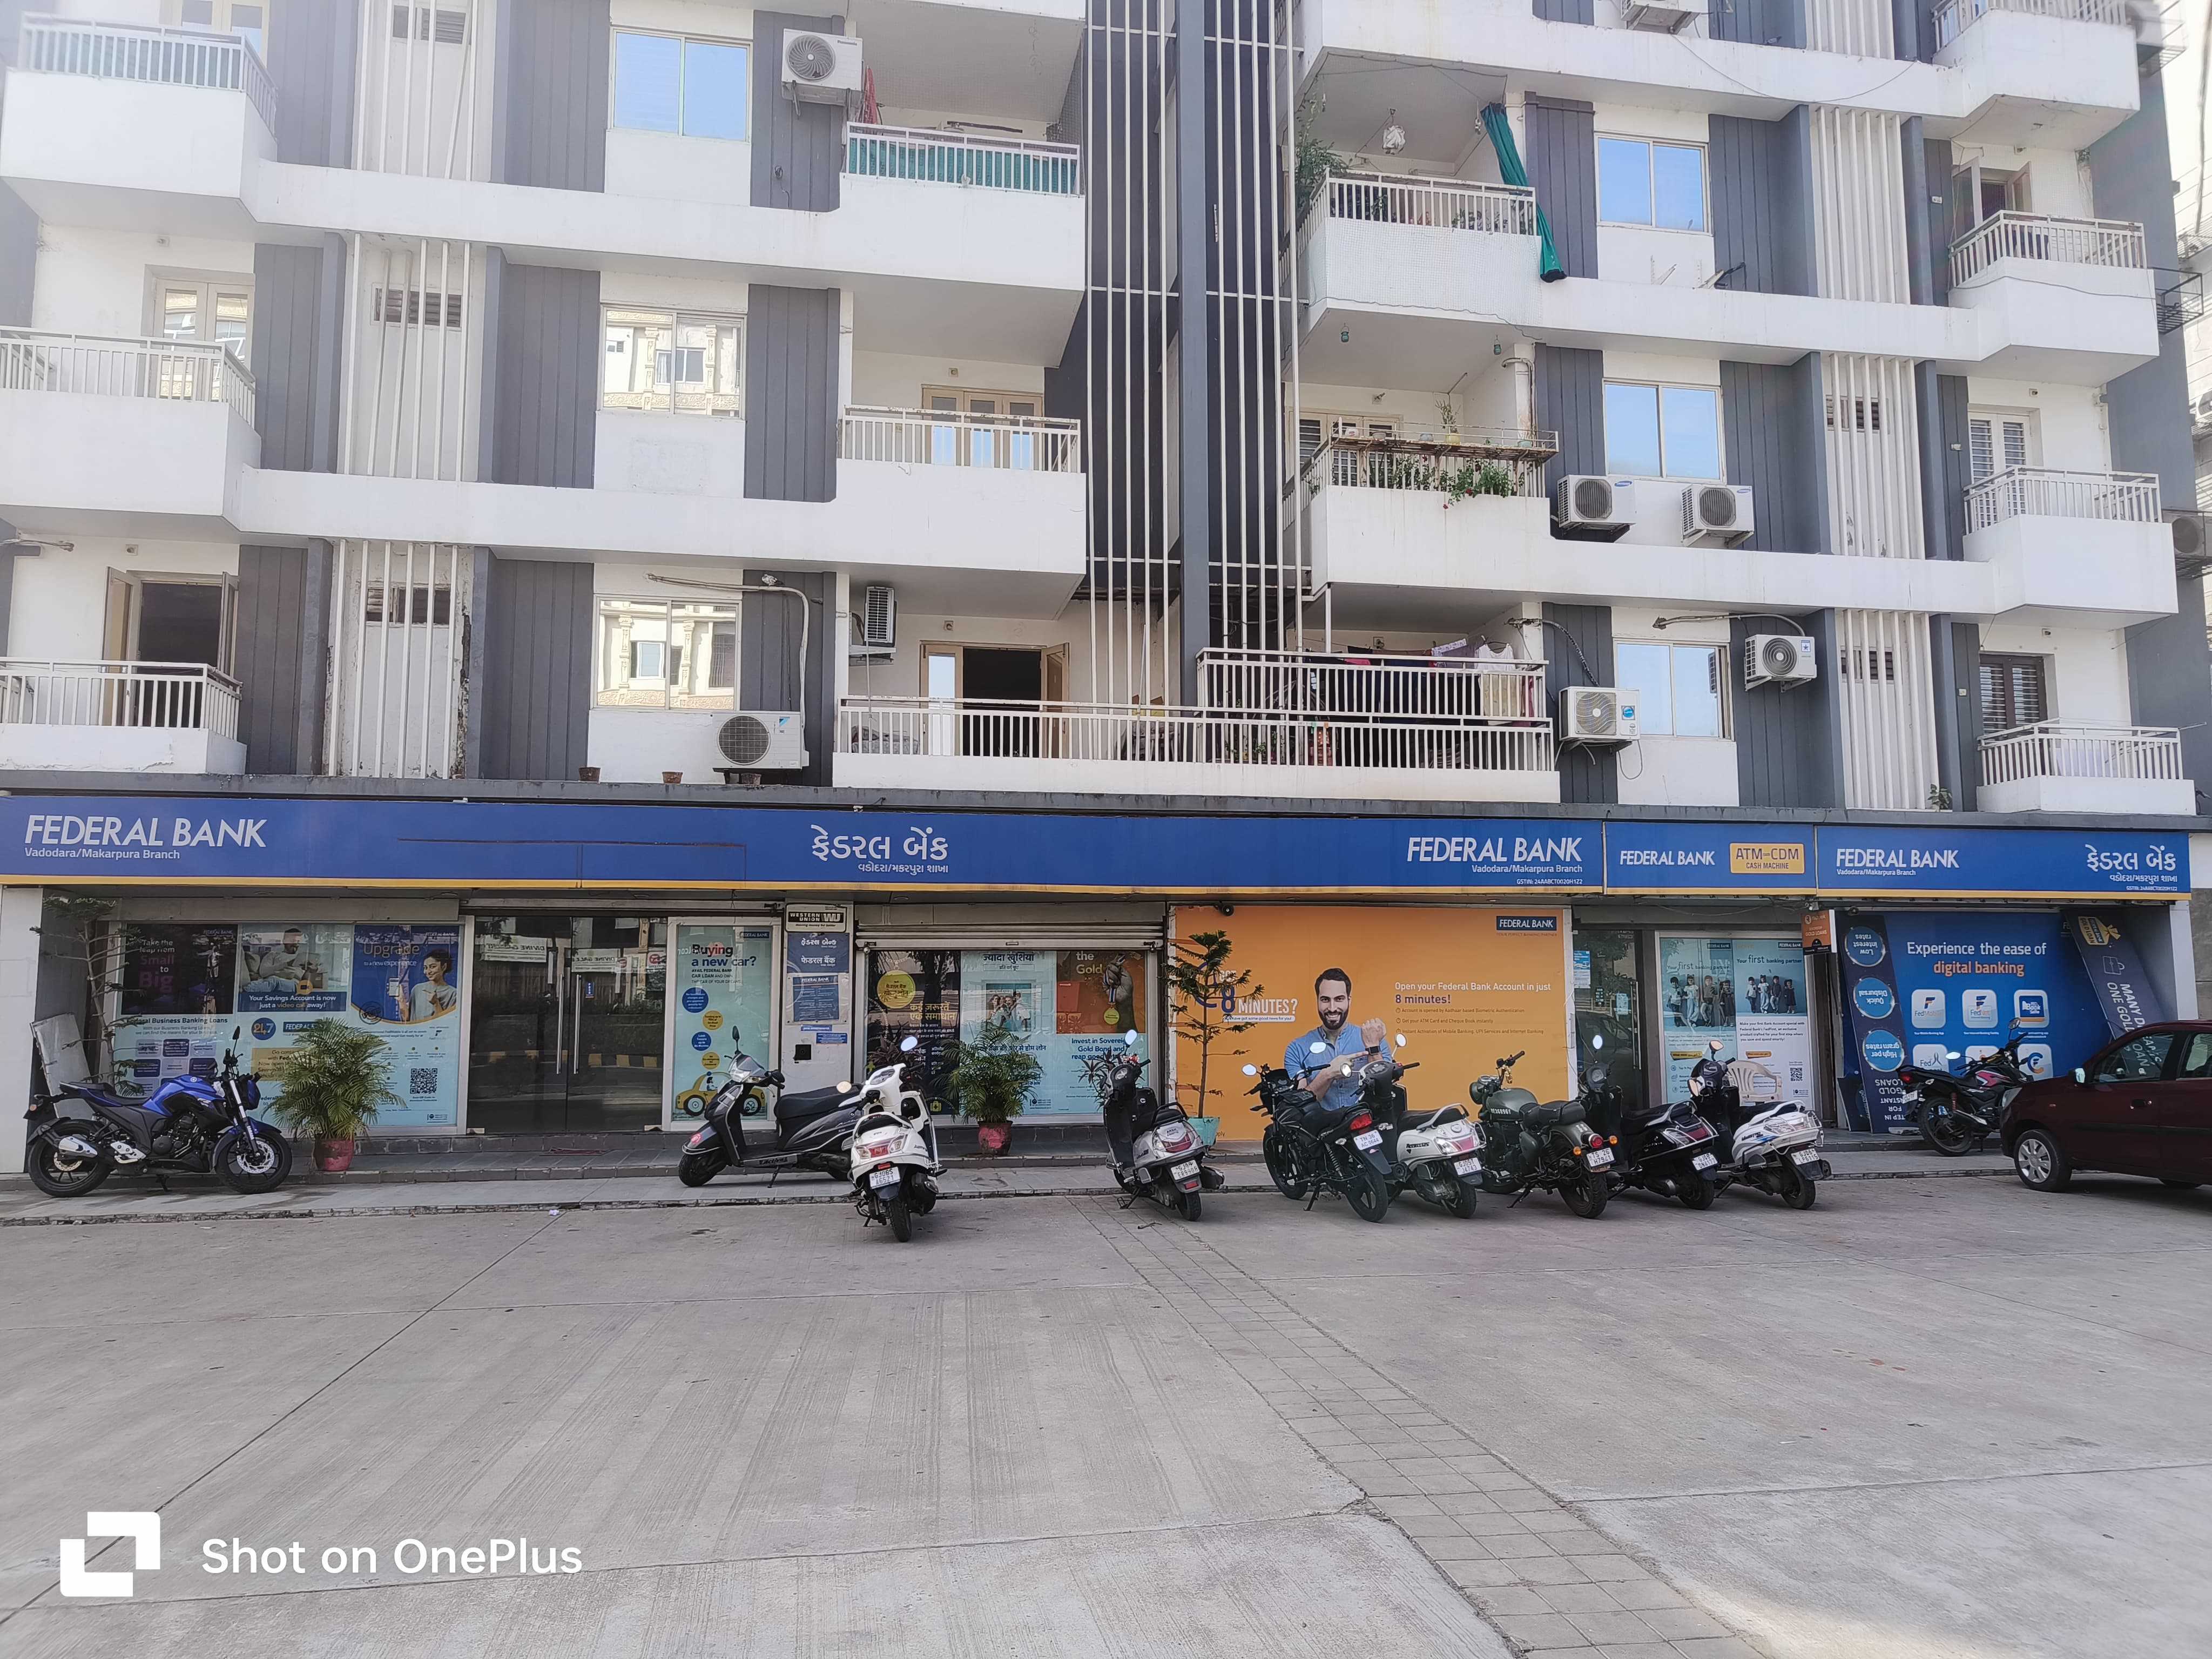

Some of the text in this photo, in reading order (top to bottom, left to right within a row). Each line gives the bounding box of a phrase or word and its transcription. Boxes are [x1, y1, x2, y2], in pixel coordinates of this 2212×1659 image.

[25, 815, 267, 848] FEDERAL BANK
[811, 824, 948, 861] ફેડરલ બેંક
[25, 848, 180, 860] Vadodara/Makarpura Branch
[1407, 837, 1583, 862] FEDERAL BANK
[1620, 850, 1715, 866] FEDERAL BANK
[1837, 848, 1959, 868] FEDERAL BANK
[2085, 844, 2176, 872] ફેડરલ બેંક
[927, 865, 949, 874] શાખા
[1472, 864, 1583, 874] Vadodara/Makarpura Branch
[822, 913, 841, 922] WU
[1499, 919, 1554, 928] FEDERAL BANK
[363, 943, 420, 958] Upgrade
[692, 943, 733, 957] Buying
[1907, 941, 2047, 957] Experience the ease of
[731, 955, 757, 967] car?
[801, 955, 822, 964] फेडरल
[1076, 950, 1094, 961] the
[1748, 954, 1764, 963] first
[1076, 964, 1103, 974] Gold
[1677, 961, 1694, 970] first
[1933, 961, 2025, 977] digital banking
[1395, 982, 1551, 993] Open your Federal Bank Account in just
[1222, 984, 1298, 1014] 8 MINUTES?
[1395, 994, 1451, 1004] 8 minutes!
[2120, 983, 2142, 1015] MANY
[909, 1012, 957, 1021] एक समाधान
[2107, 982, 2150, 1067] ONE GOL OAN
[1874, 1078, 1904, 1087] LOANS
